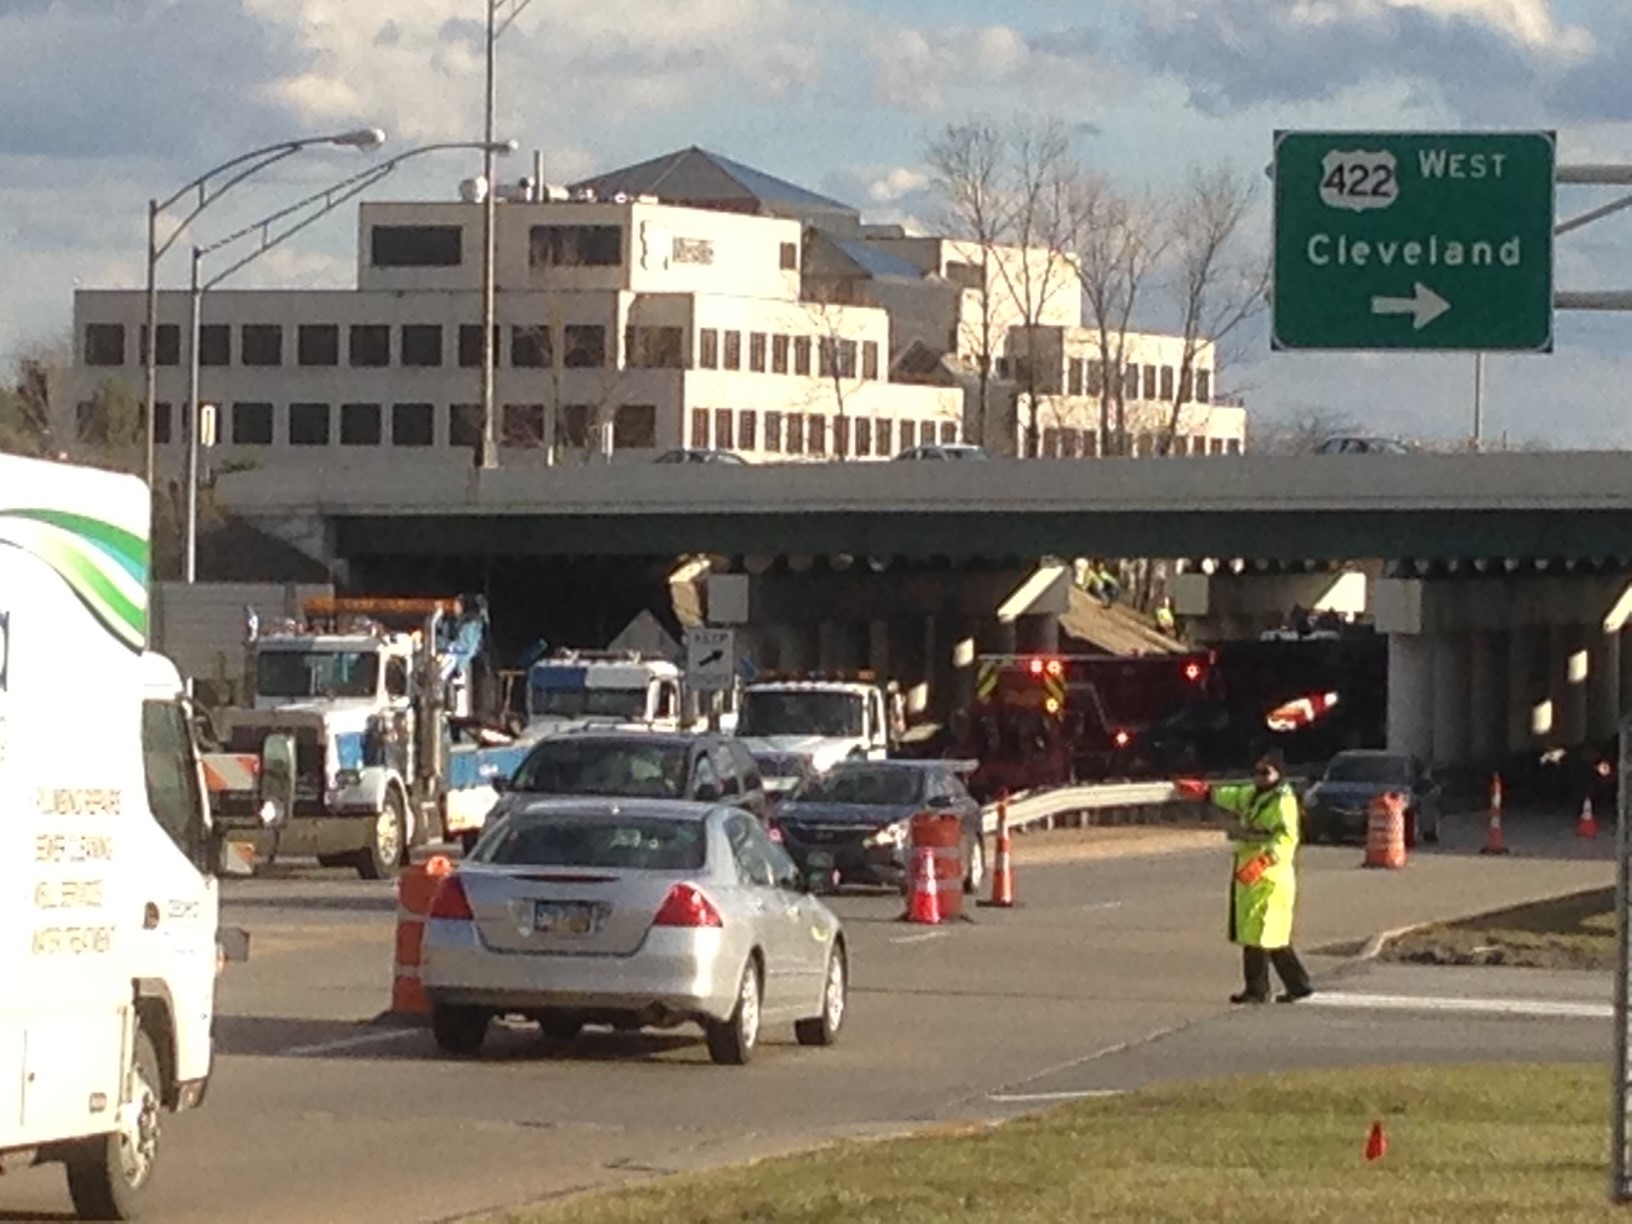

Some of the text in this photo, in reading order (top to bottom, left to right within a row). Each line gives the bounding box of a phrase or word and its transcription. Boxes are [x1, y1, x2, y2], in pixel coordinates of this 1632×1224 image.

[1324, 150, 1507, 198] 422 WEST
[1307, 234, 1522, 266] Cleveland
